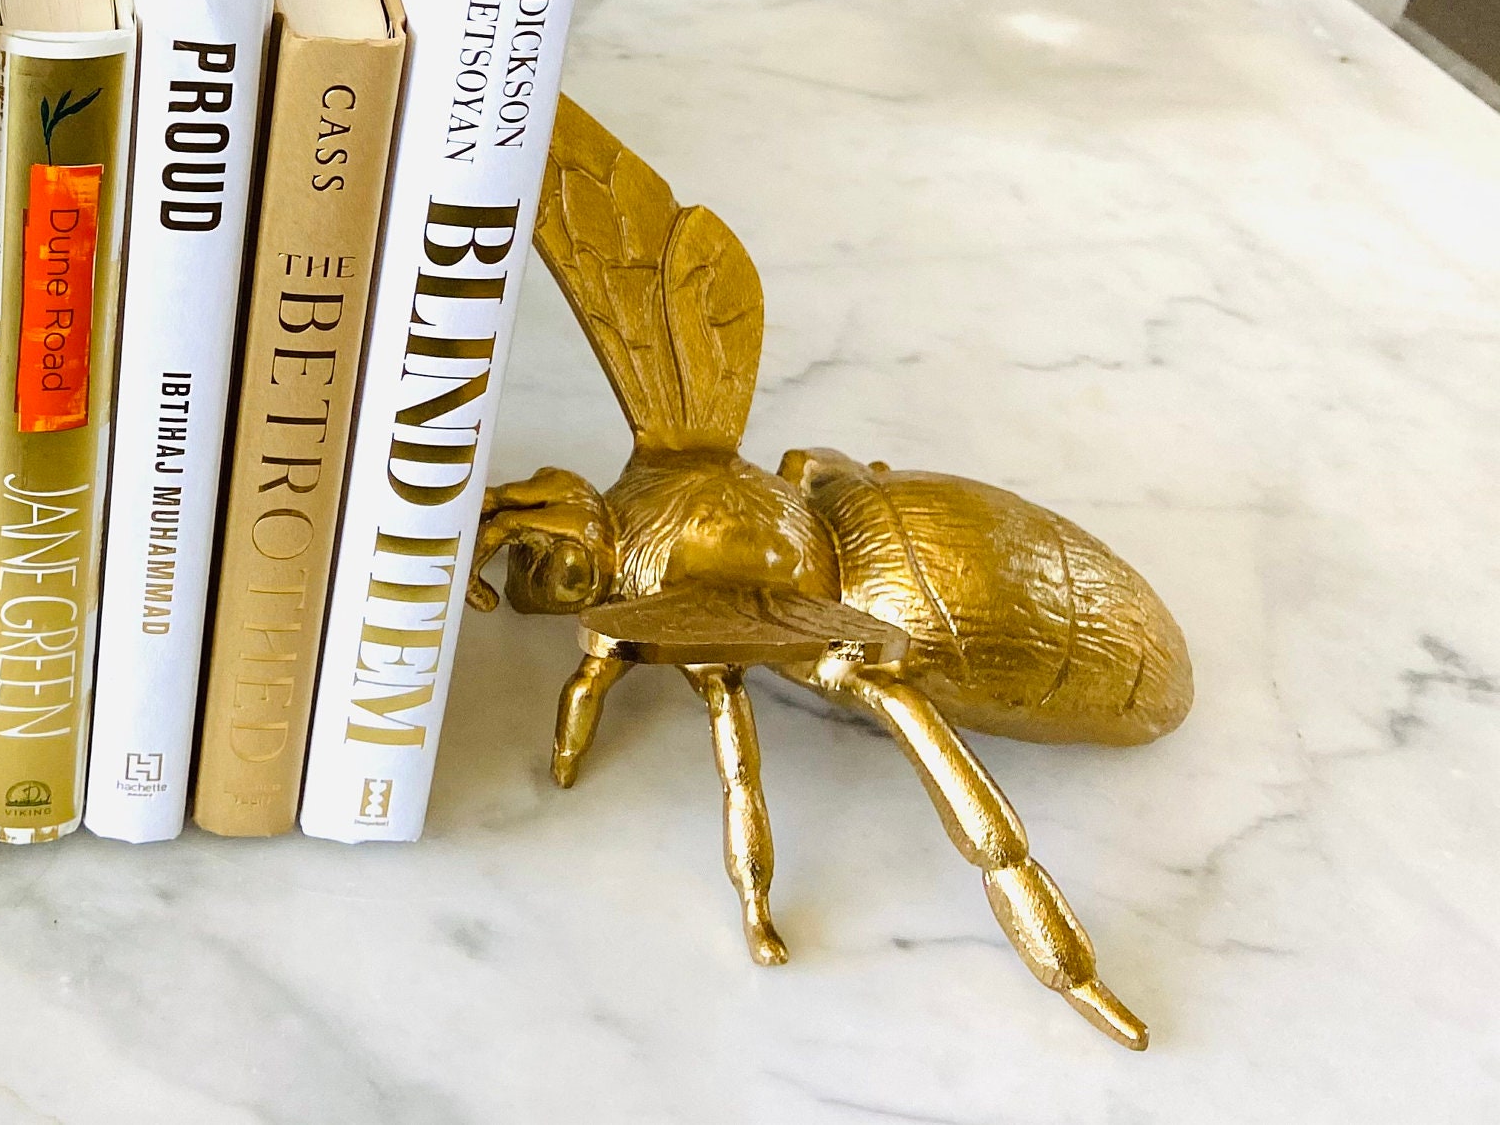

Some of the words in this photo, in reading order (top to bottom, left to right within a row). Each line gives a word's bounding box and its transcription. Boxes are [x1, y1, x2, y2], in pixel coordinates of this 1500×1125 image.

[159, 39, 237, 233] PROUD
[311, 84, 357, 192] CASS
[45, 209, 80, 298] Dune
[278, 252, 357, 279] THE
[41, 307, 75, 392] Road
[387, 194, 521, 507] BLIND
[155, 372, 192, 474] IBTIHAJ
[141, 486, 182, 635] MUHAMMAD
[229, 291, 345, 763] BETROTHED
[344, 525, 462, 750] ITEM
[4, 807, 52, 816] VIKING
[116, 780, 168, 792] hachette
